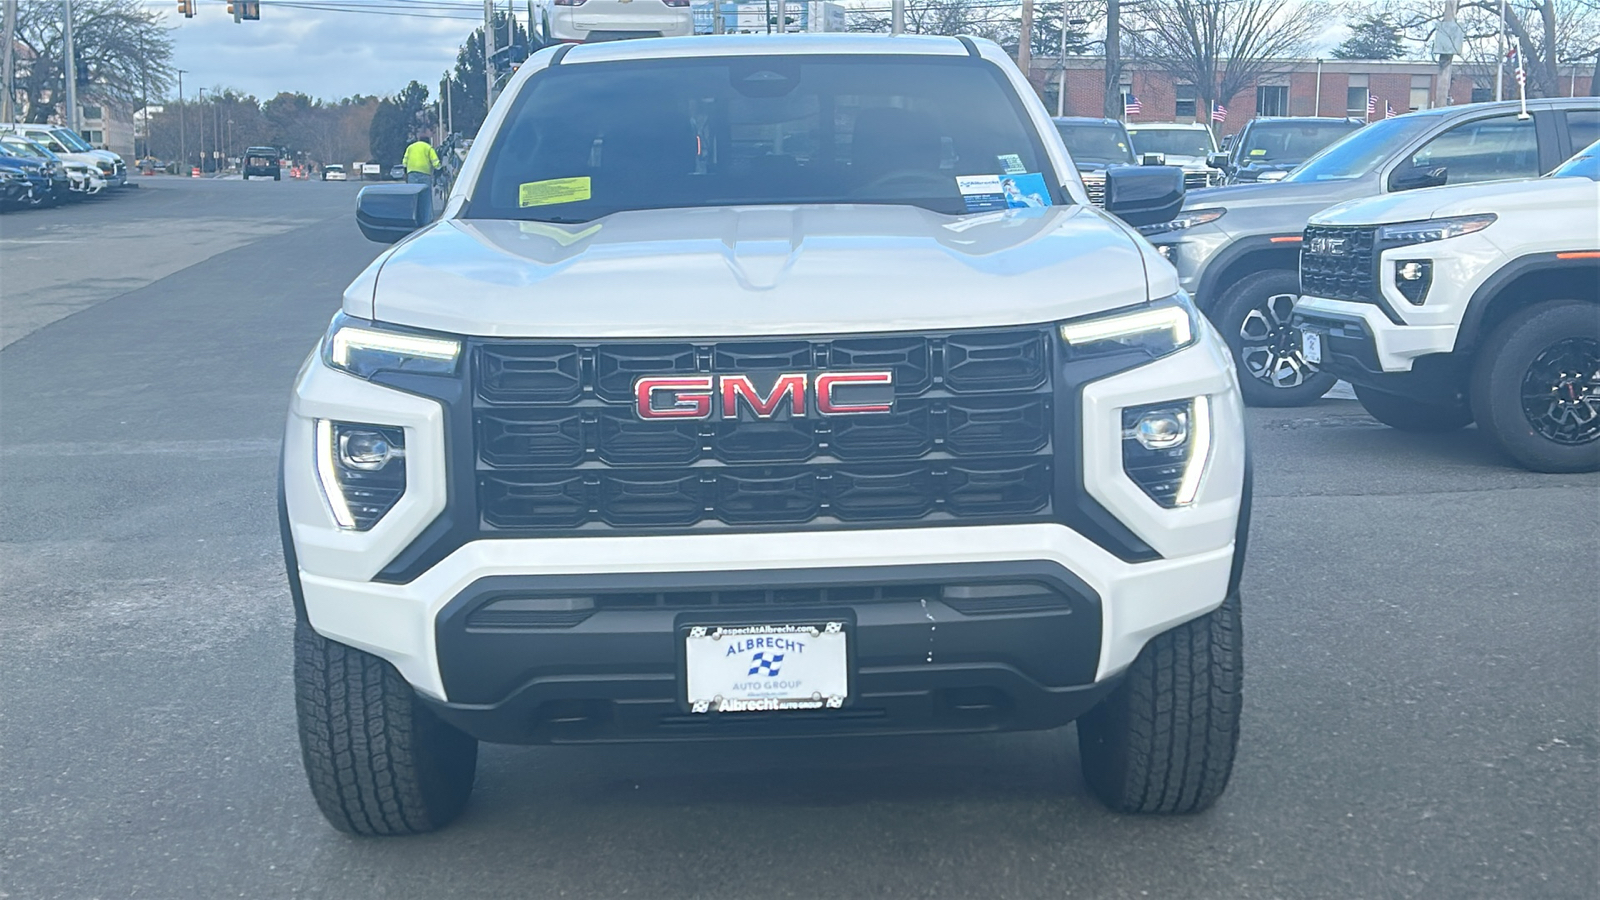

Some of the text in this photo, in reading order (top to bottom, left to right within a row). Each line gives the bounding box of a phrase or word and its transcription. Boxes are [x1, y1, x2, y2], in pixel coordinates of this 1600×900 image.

[634, 371, 893, 420] GMC
[726, 637, 805, 657] ALBRECHT
[732, 680, 803, 691] AUTO GROUP
[719, 698, 779, 712] Albrecht
